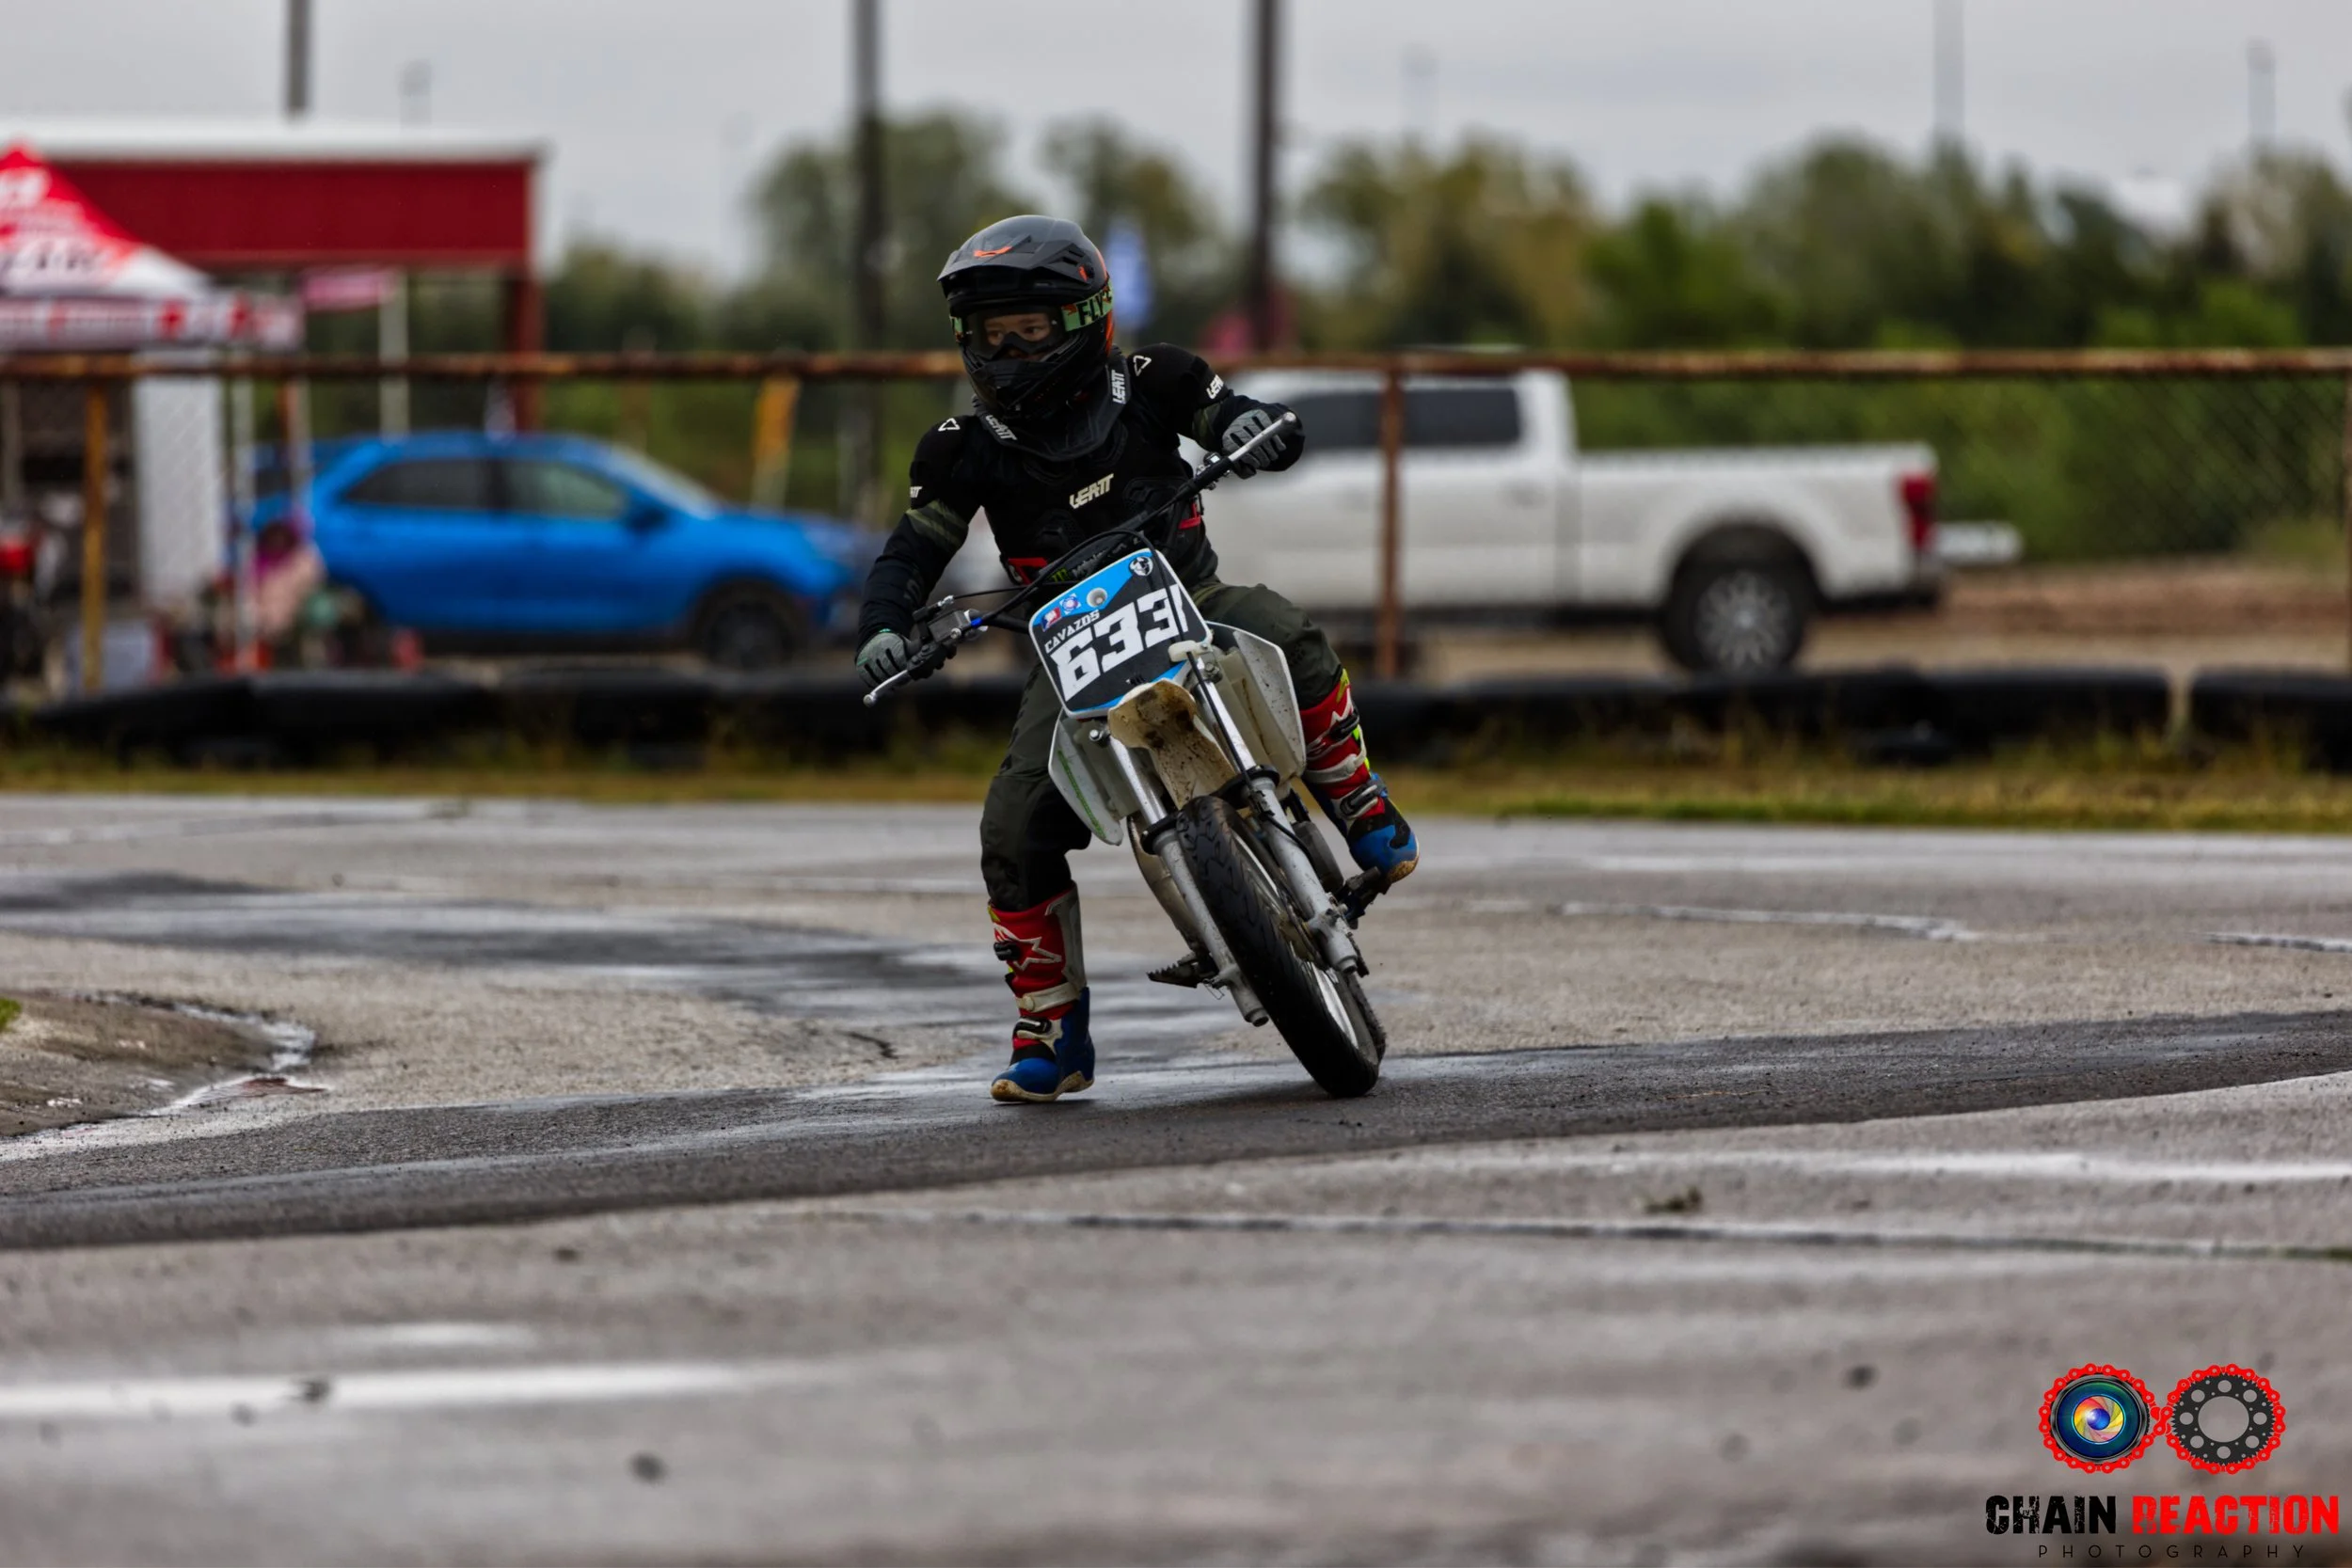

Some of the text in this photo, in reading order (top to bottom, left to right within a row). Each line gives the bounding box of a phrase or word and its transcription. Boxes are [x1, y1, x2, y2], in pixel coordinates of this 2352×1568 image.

[1111, 370, 1127, 404] LEATT
[986, 415, 1018, 440] LEATT
[1069, 473, 1114, 509] LEATT
[1044, 610, 1100, 654] CAVAZOS
[1050, 584, 1188, 702] 633
